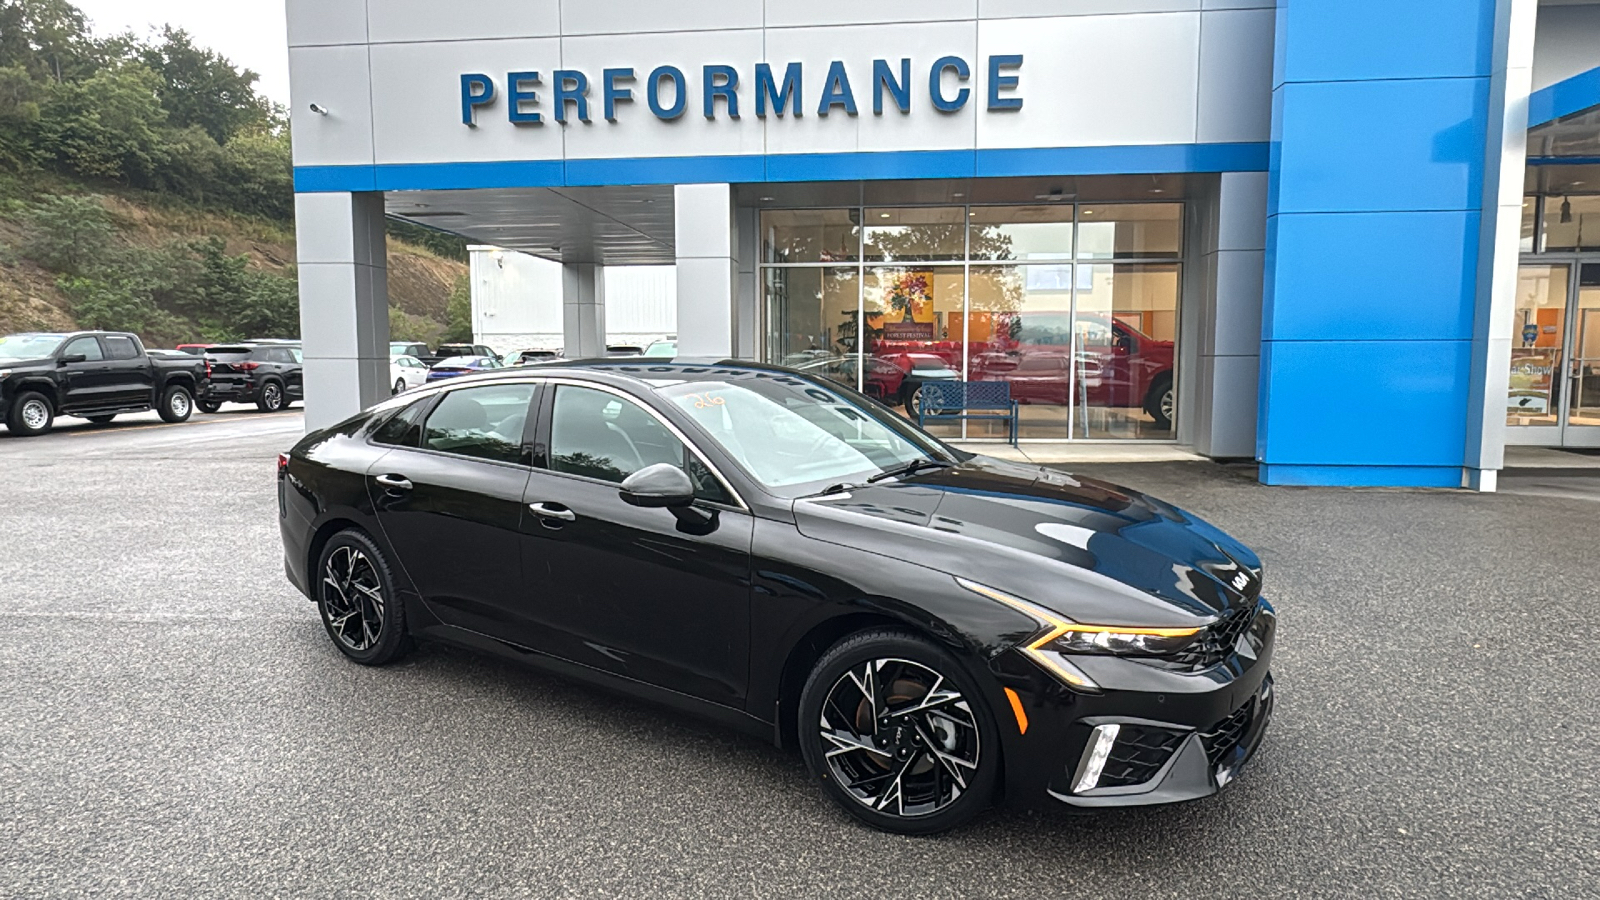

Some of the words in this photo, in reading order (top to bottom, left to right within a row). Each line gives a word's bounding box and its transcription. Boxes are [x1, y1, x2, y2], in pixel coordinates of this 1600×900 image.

[460, 54, 1024, 127] PERFORMANCE
[1525, 363, 1552, 375] Show
[684, 392, 726, 409] 26
